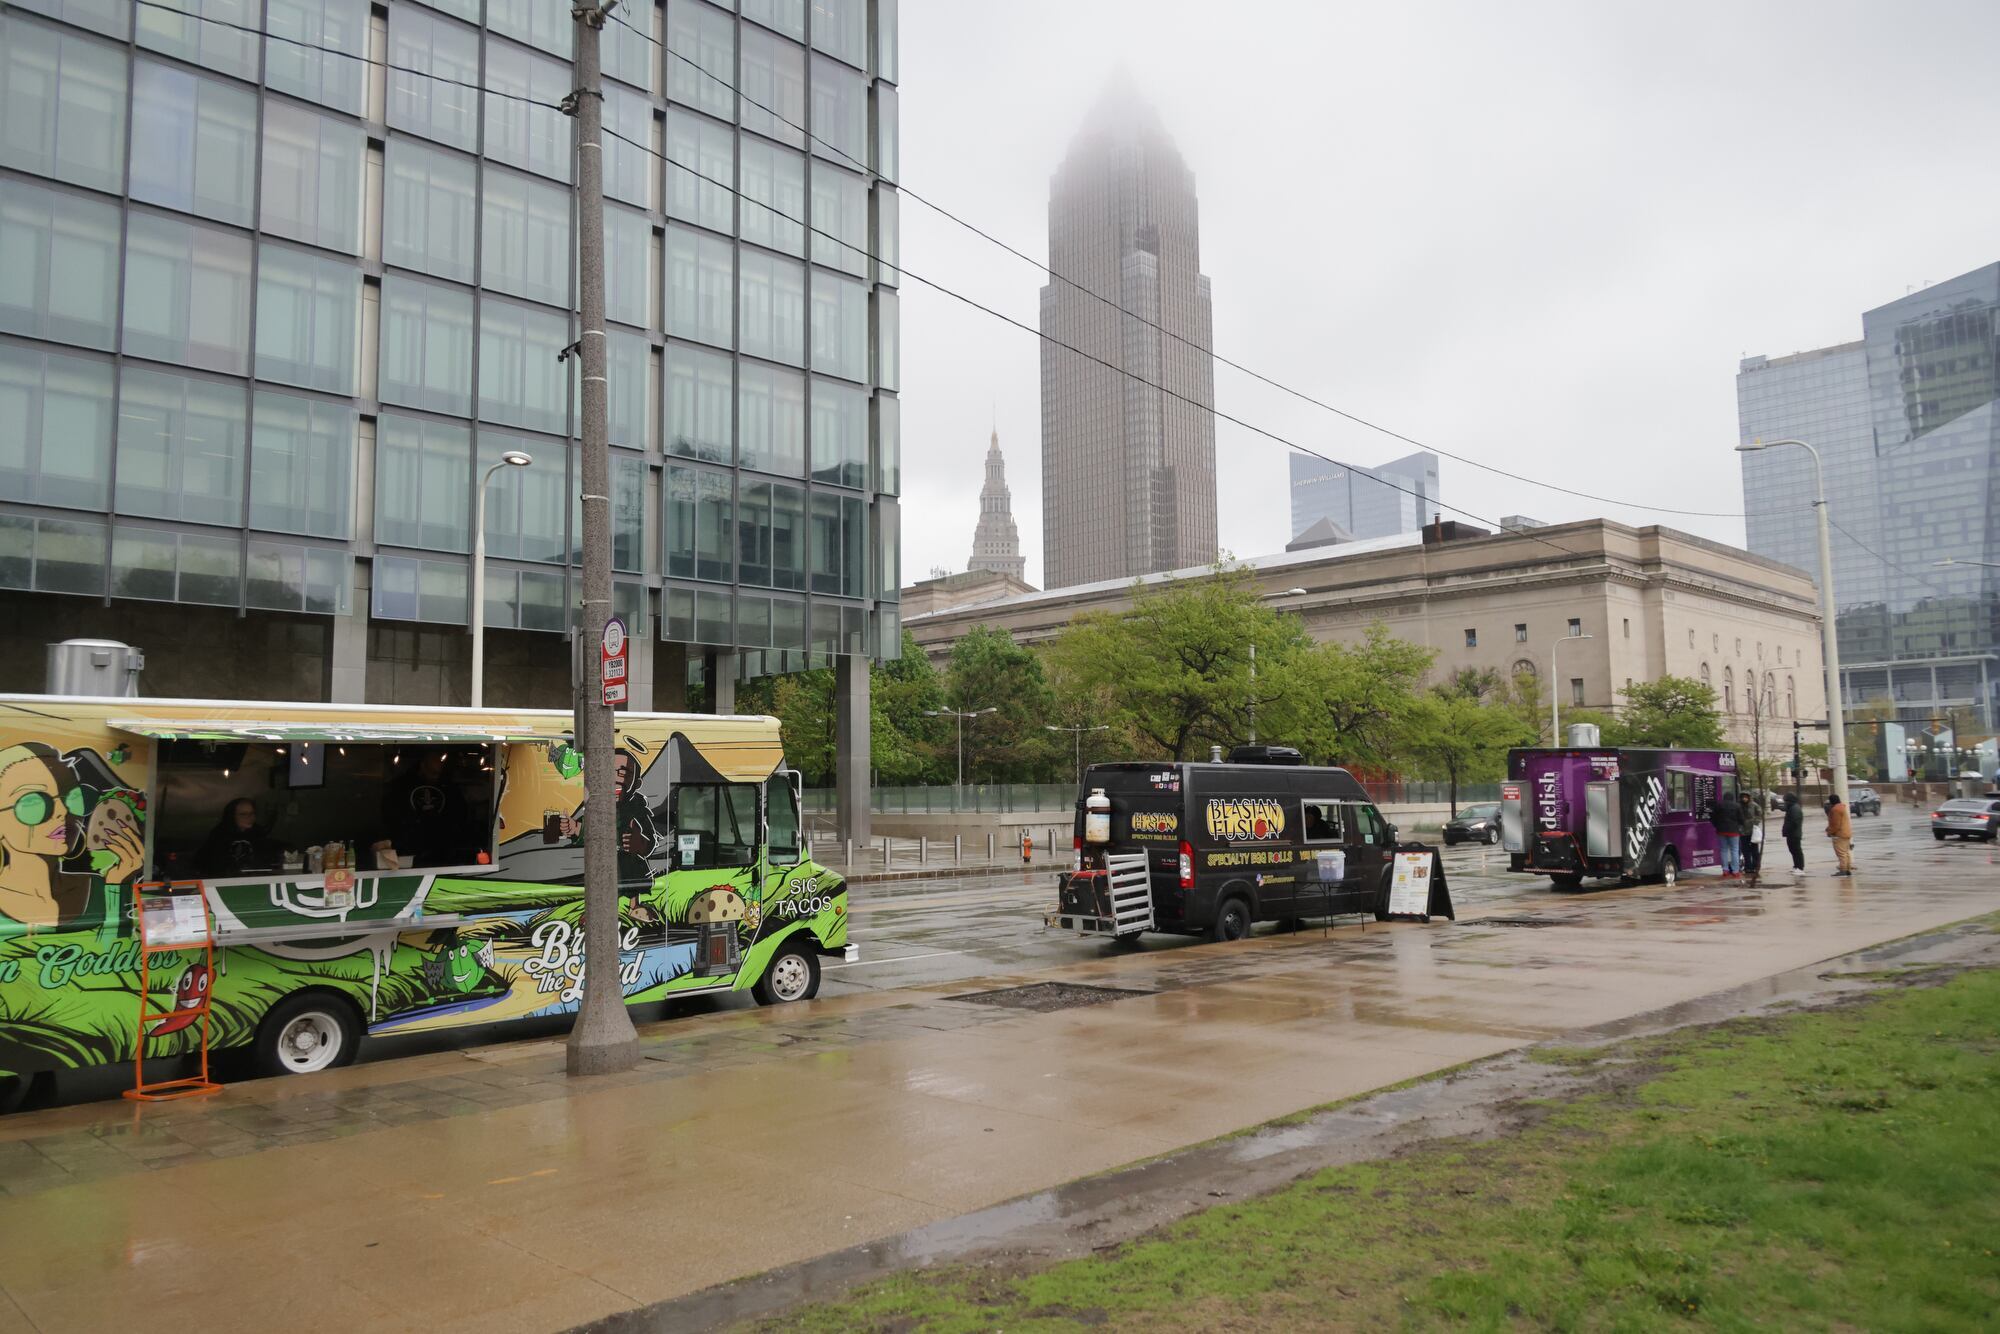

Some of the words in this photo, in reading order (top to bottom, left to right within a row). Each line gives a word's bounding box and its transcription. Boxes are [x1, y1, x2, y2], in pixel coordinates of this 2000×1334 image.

[1209, 798, 1278, 820] BLASIAN
[1538, 771, 1557, 830] delish
[1133, 812, 1175, 823] BLASIAN
[1134, 821, 1174, 832] FUSION
[1628, 775, 1663, 860] delish
[1212, 818, 1280, 841] FUSION
[1207, 852, 1250, 867] SPECIALTY
[1250, 851, 1267, 865] EGG
[1267, 850, 1293, 864] ROLLS
[790, 877, 817, 895] SIG
[775, 896, 832, 916] TACOS
[531, 971, 566, 993] The
